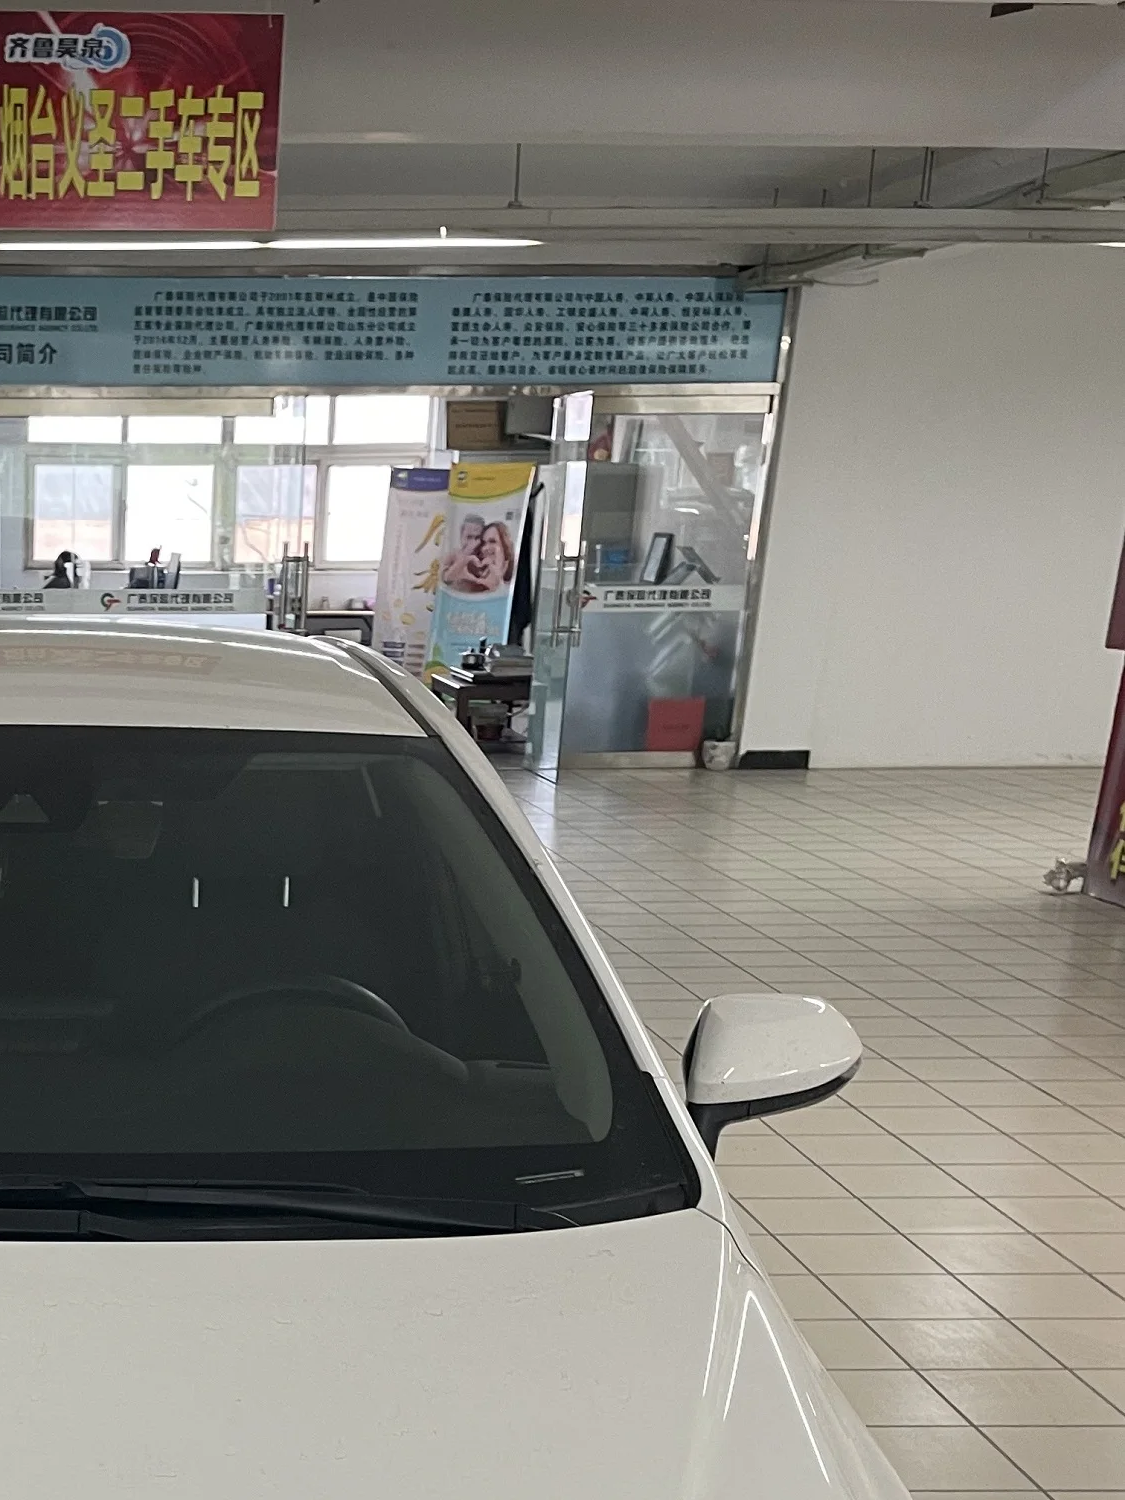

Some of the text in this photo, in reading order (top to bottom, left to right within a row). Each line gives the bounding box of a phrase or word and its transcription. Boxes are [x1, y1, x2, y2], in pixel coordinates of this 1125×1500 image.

[0, 84, 264, 201] 烟台义圣二手车专区
